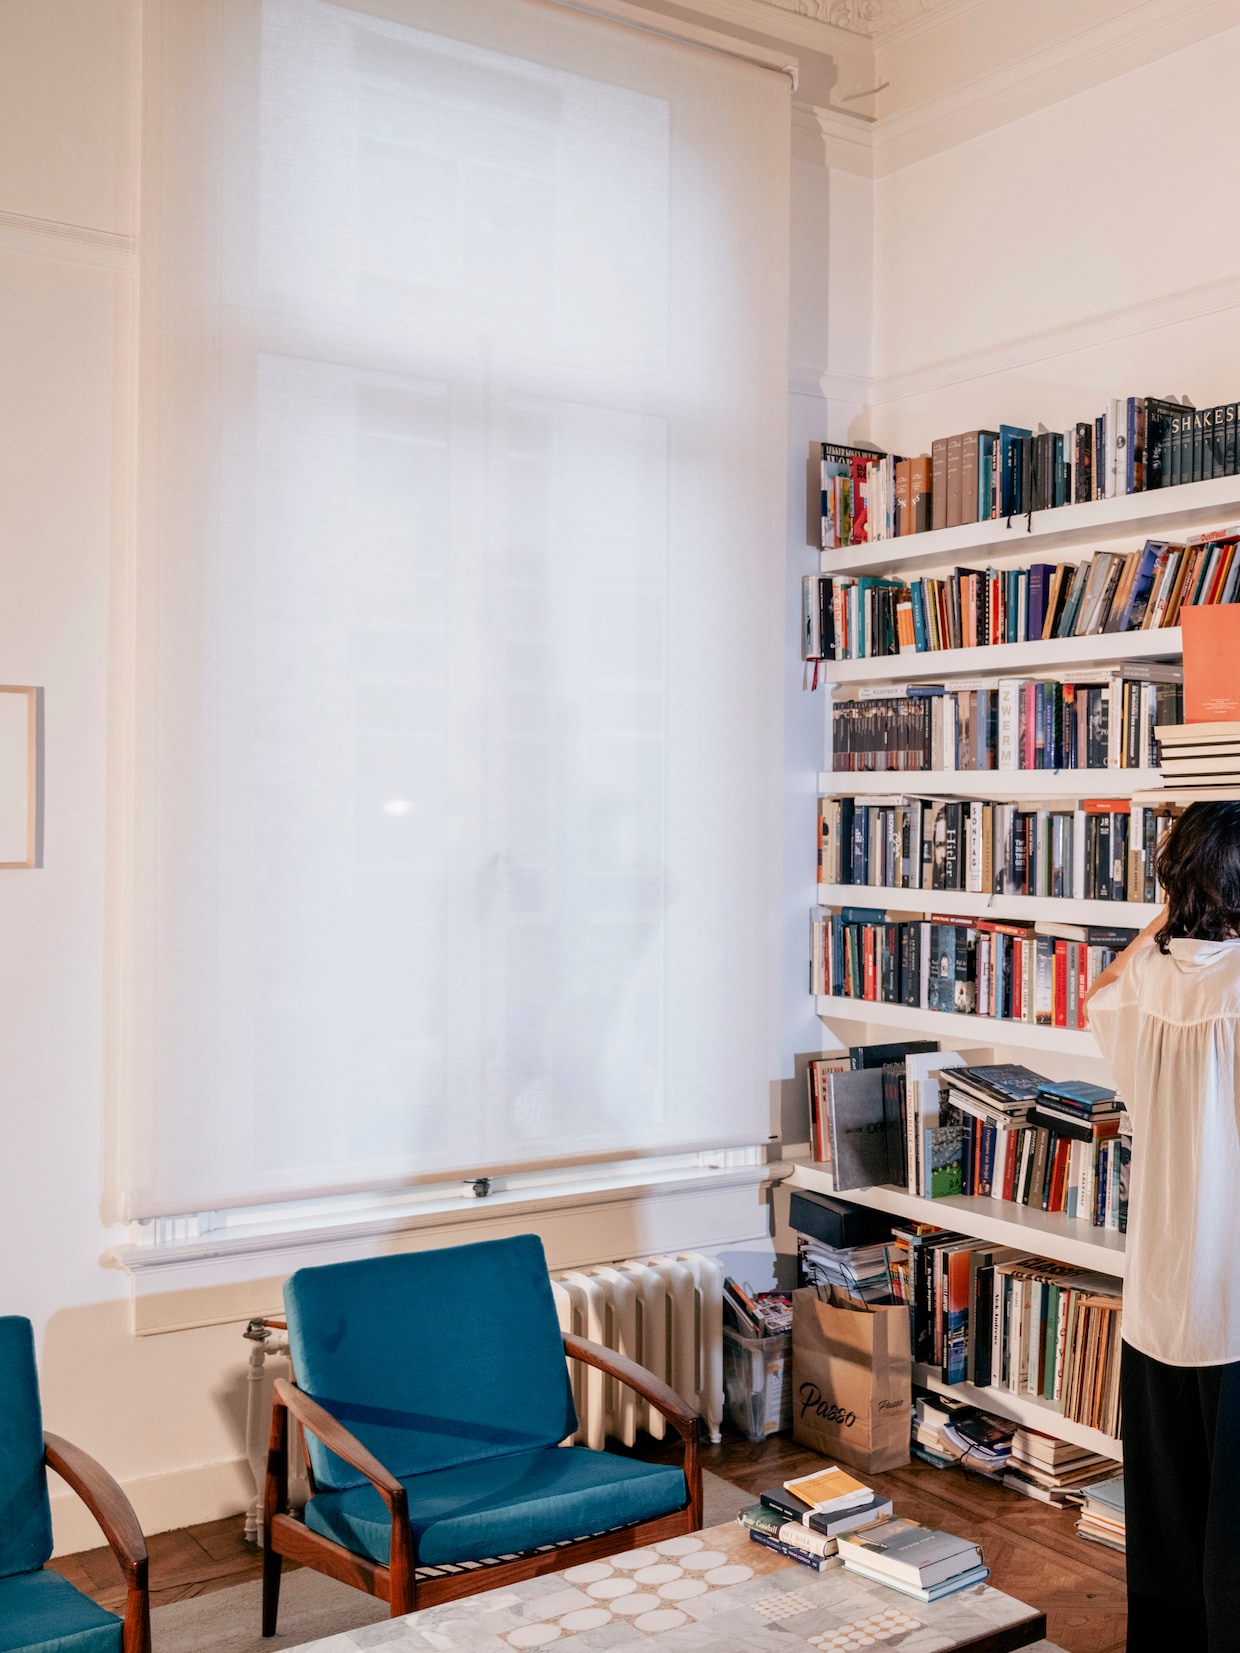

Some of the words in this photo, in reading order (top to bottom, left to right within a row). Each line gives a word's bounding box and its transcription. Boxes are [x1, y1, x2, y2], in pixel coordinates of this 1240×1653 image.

[1002, 690, 1012, 761] ZWERM
[1100, 817, 1110, 827] JR
[946, 829, 956, 878] Hitler
[799, 1382, 857, 1428] Passo
[877, 1398, 904, 1413] Passo
[756, 1520, 778, 1534] Goodall
